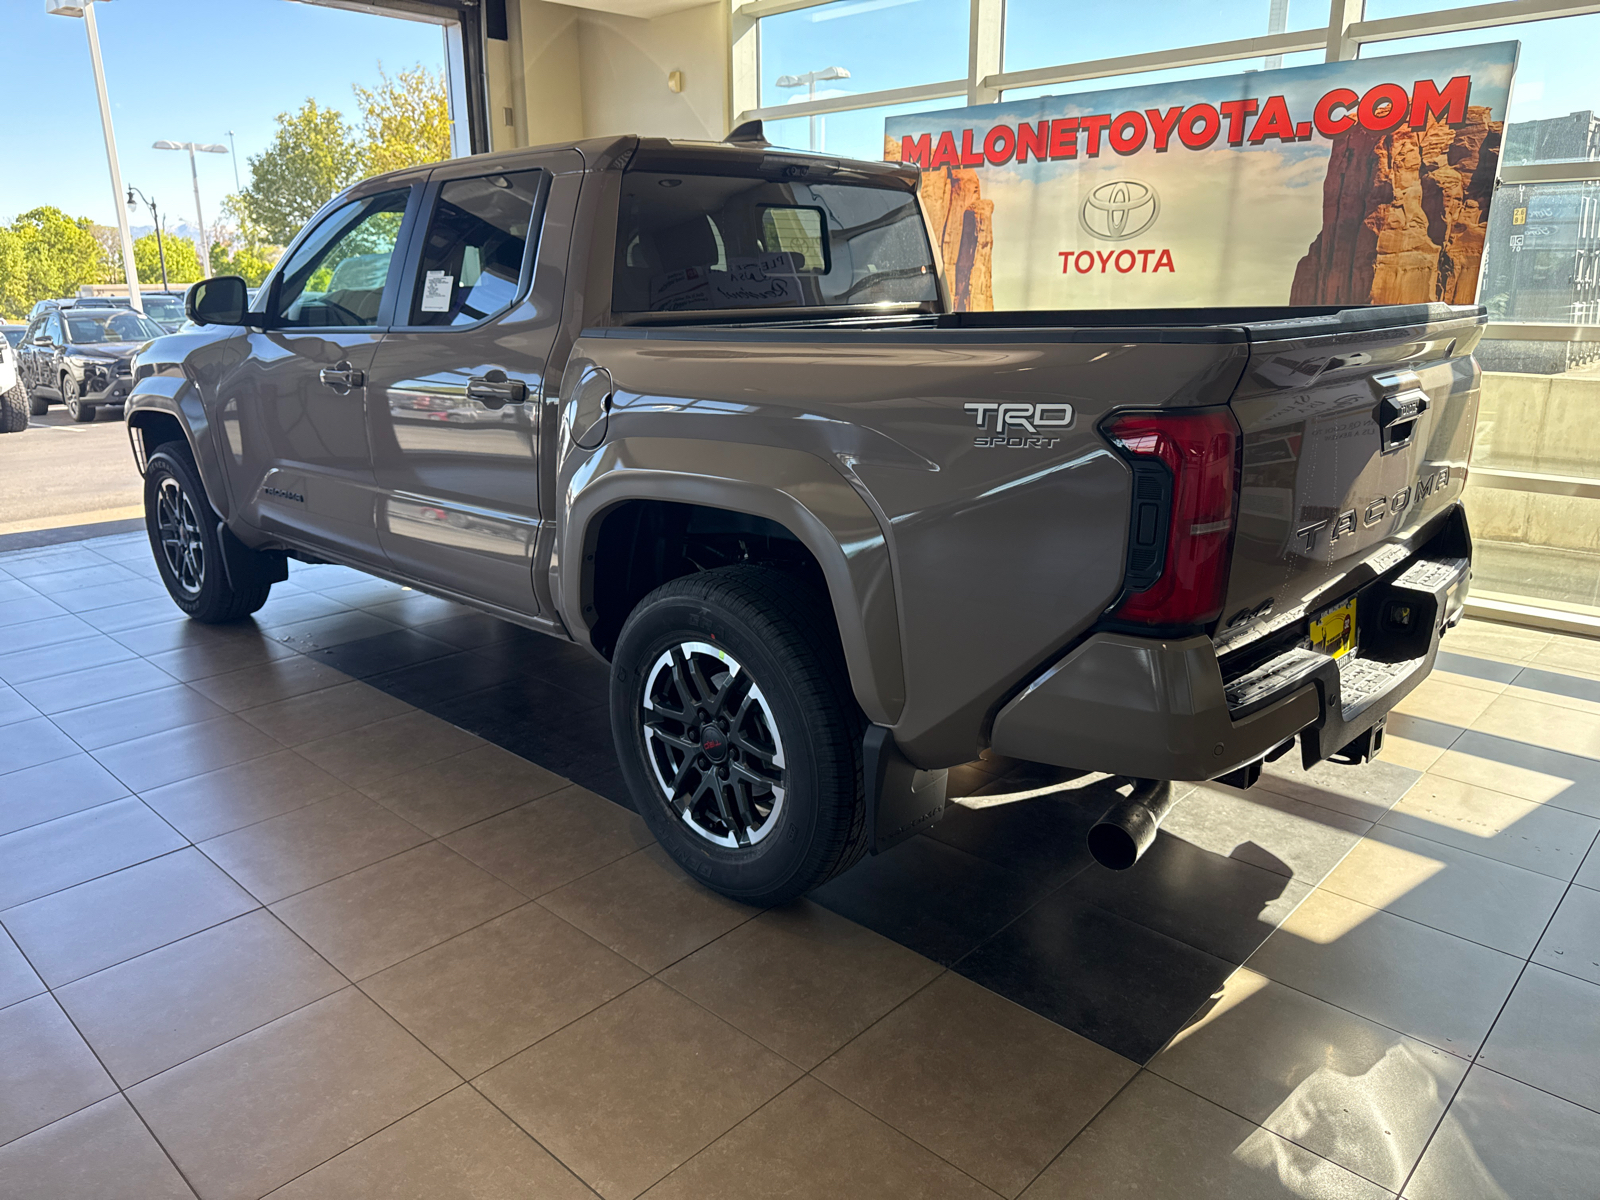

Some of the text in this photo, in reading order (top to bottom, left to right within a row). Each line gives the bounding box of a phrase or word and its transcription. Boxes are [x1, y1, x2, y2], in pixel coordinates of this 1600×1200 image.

[901, 76, 1472, 170] MALONETOYOTA.COM
[1058, 249, 1176, 274] TOYOTA
[964, 402, 1075, 434] TRD
[974, 436, 1060, 449] SPORT
[1297, 467, 1450, 552] TACOMA
